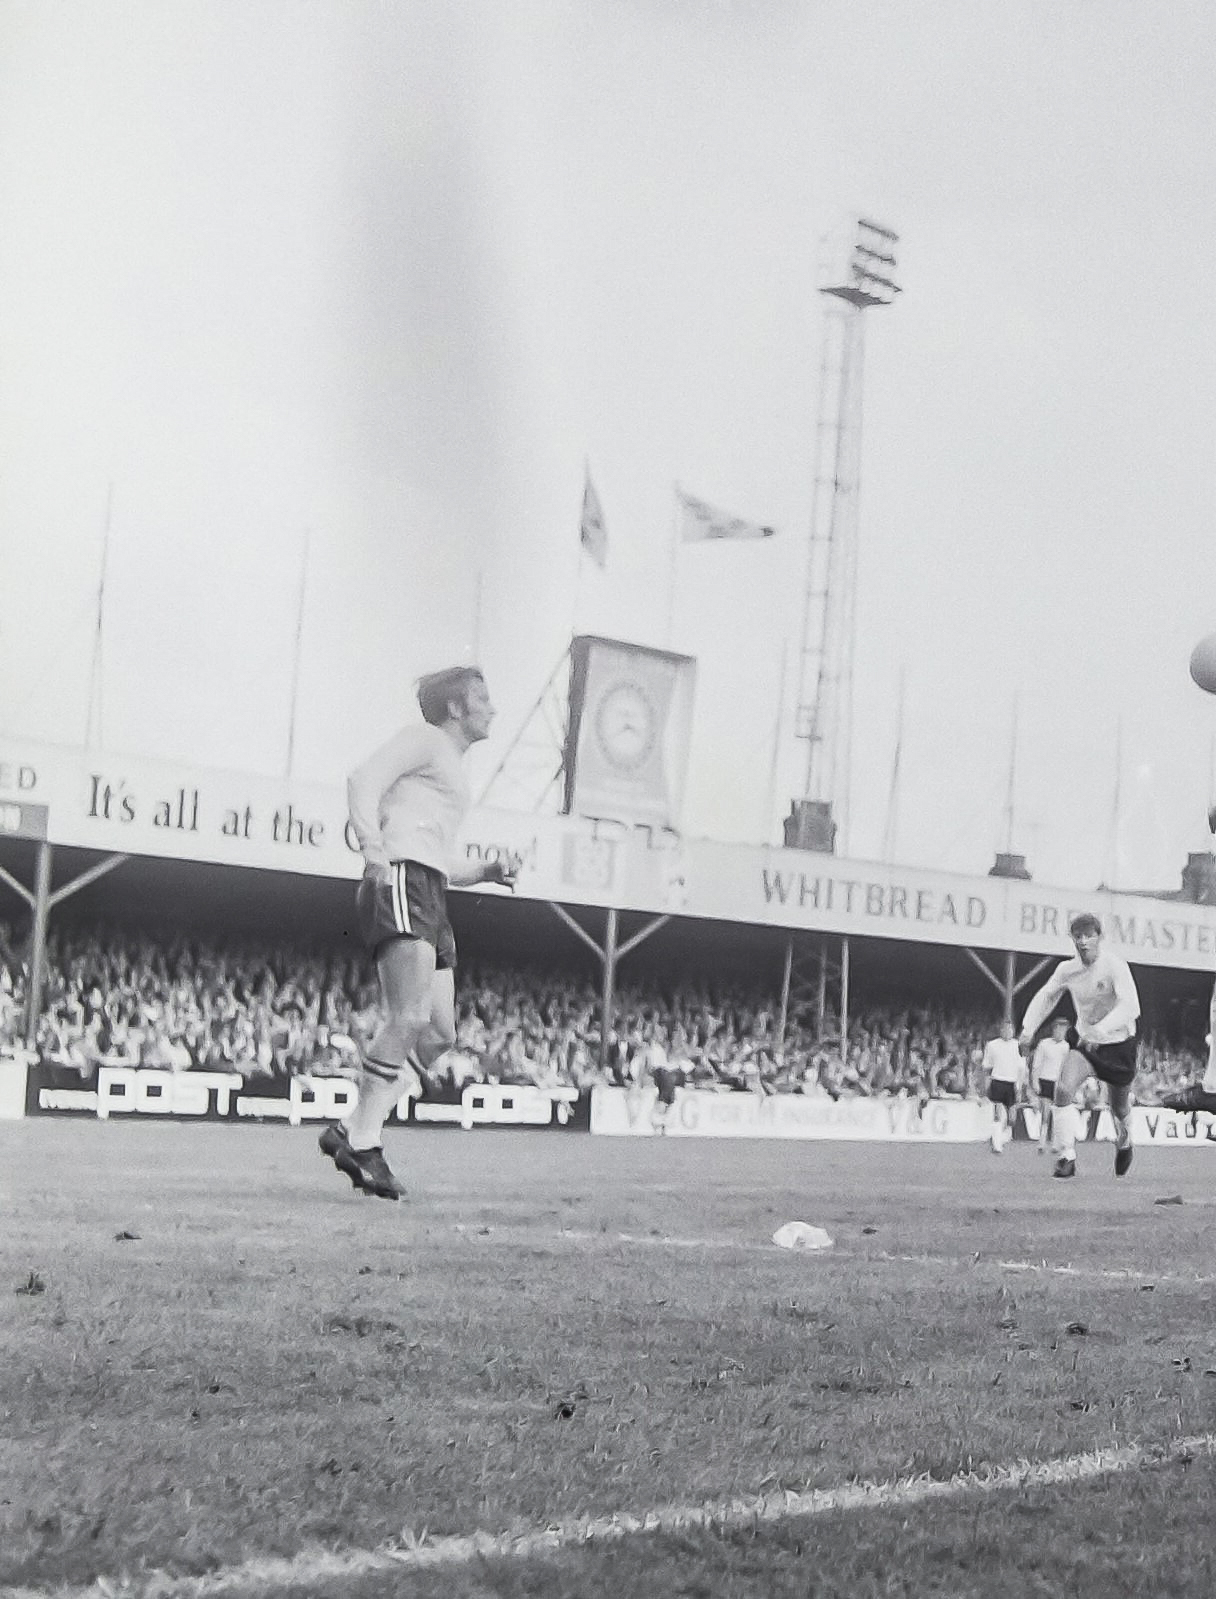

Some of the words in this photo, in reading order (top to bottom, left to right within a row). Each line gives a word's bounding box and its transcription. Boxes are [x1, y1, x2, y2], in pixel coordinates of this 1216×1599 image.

[88, 774, 135, 824] It's
[154, 788, 199, 831] all
[222, 806, 251, 839] at
[273, 805, 324, 847] the
[761, 869, 987, 928] WHITBREAD
